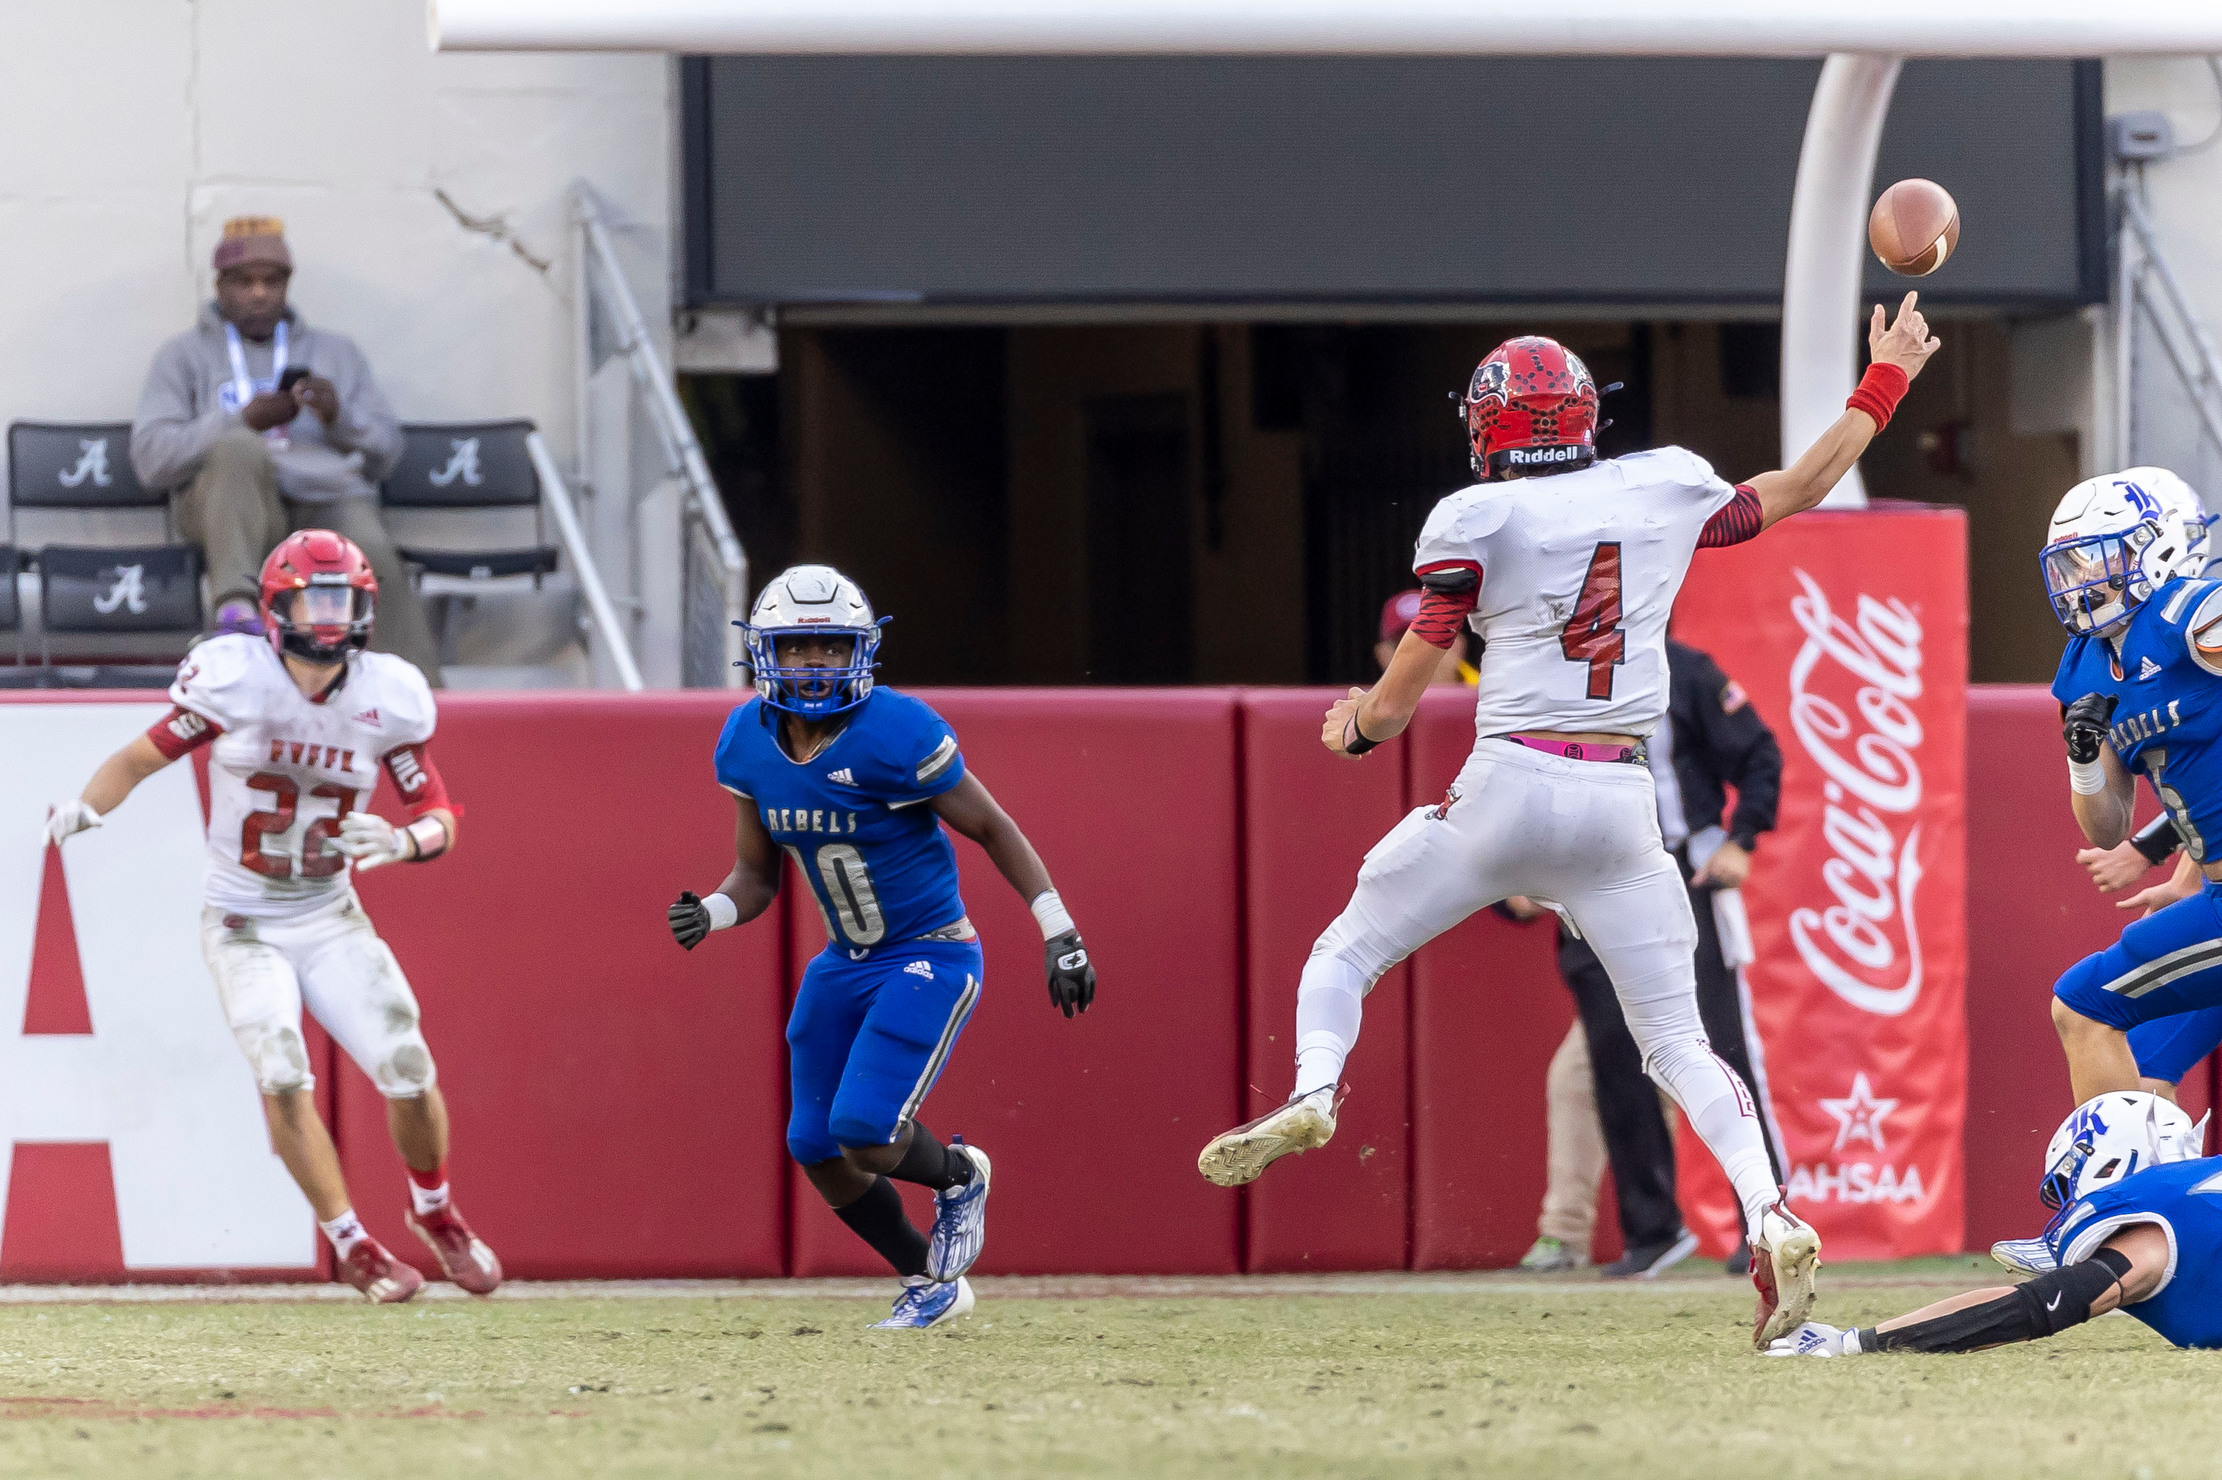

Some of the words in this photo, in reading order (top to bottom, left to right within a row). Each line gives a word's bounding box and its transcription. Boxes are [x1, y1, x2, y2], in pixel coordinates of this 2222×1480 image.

[1508, 445, 1579, 464] Riddell
[1559, 540, 1627, 702] 4
[2109, 698, 2181, 751] REBELS
[1789, 566, 1925, 1016] Coca-Cola
[240, 771, 358, 879] 22
[767, 808, 857, 834] REBELS
[1786, 1163, 1925, 1203] AHSAA
[1798, 1337, 1828, 1354] adidas
